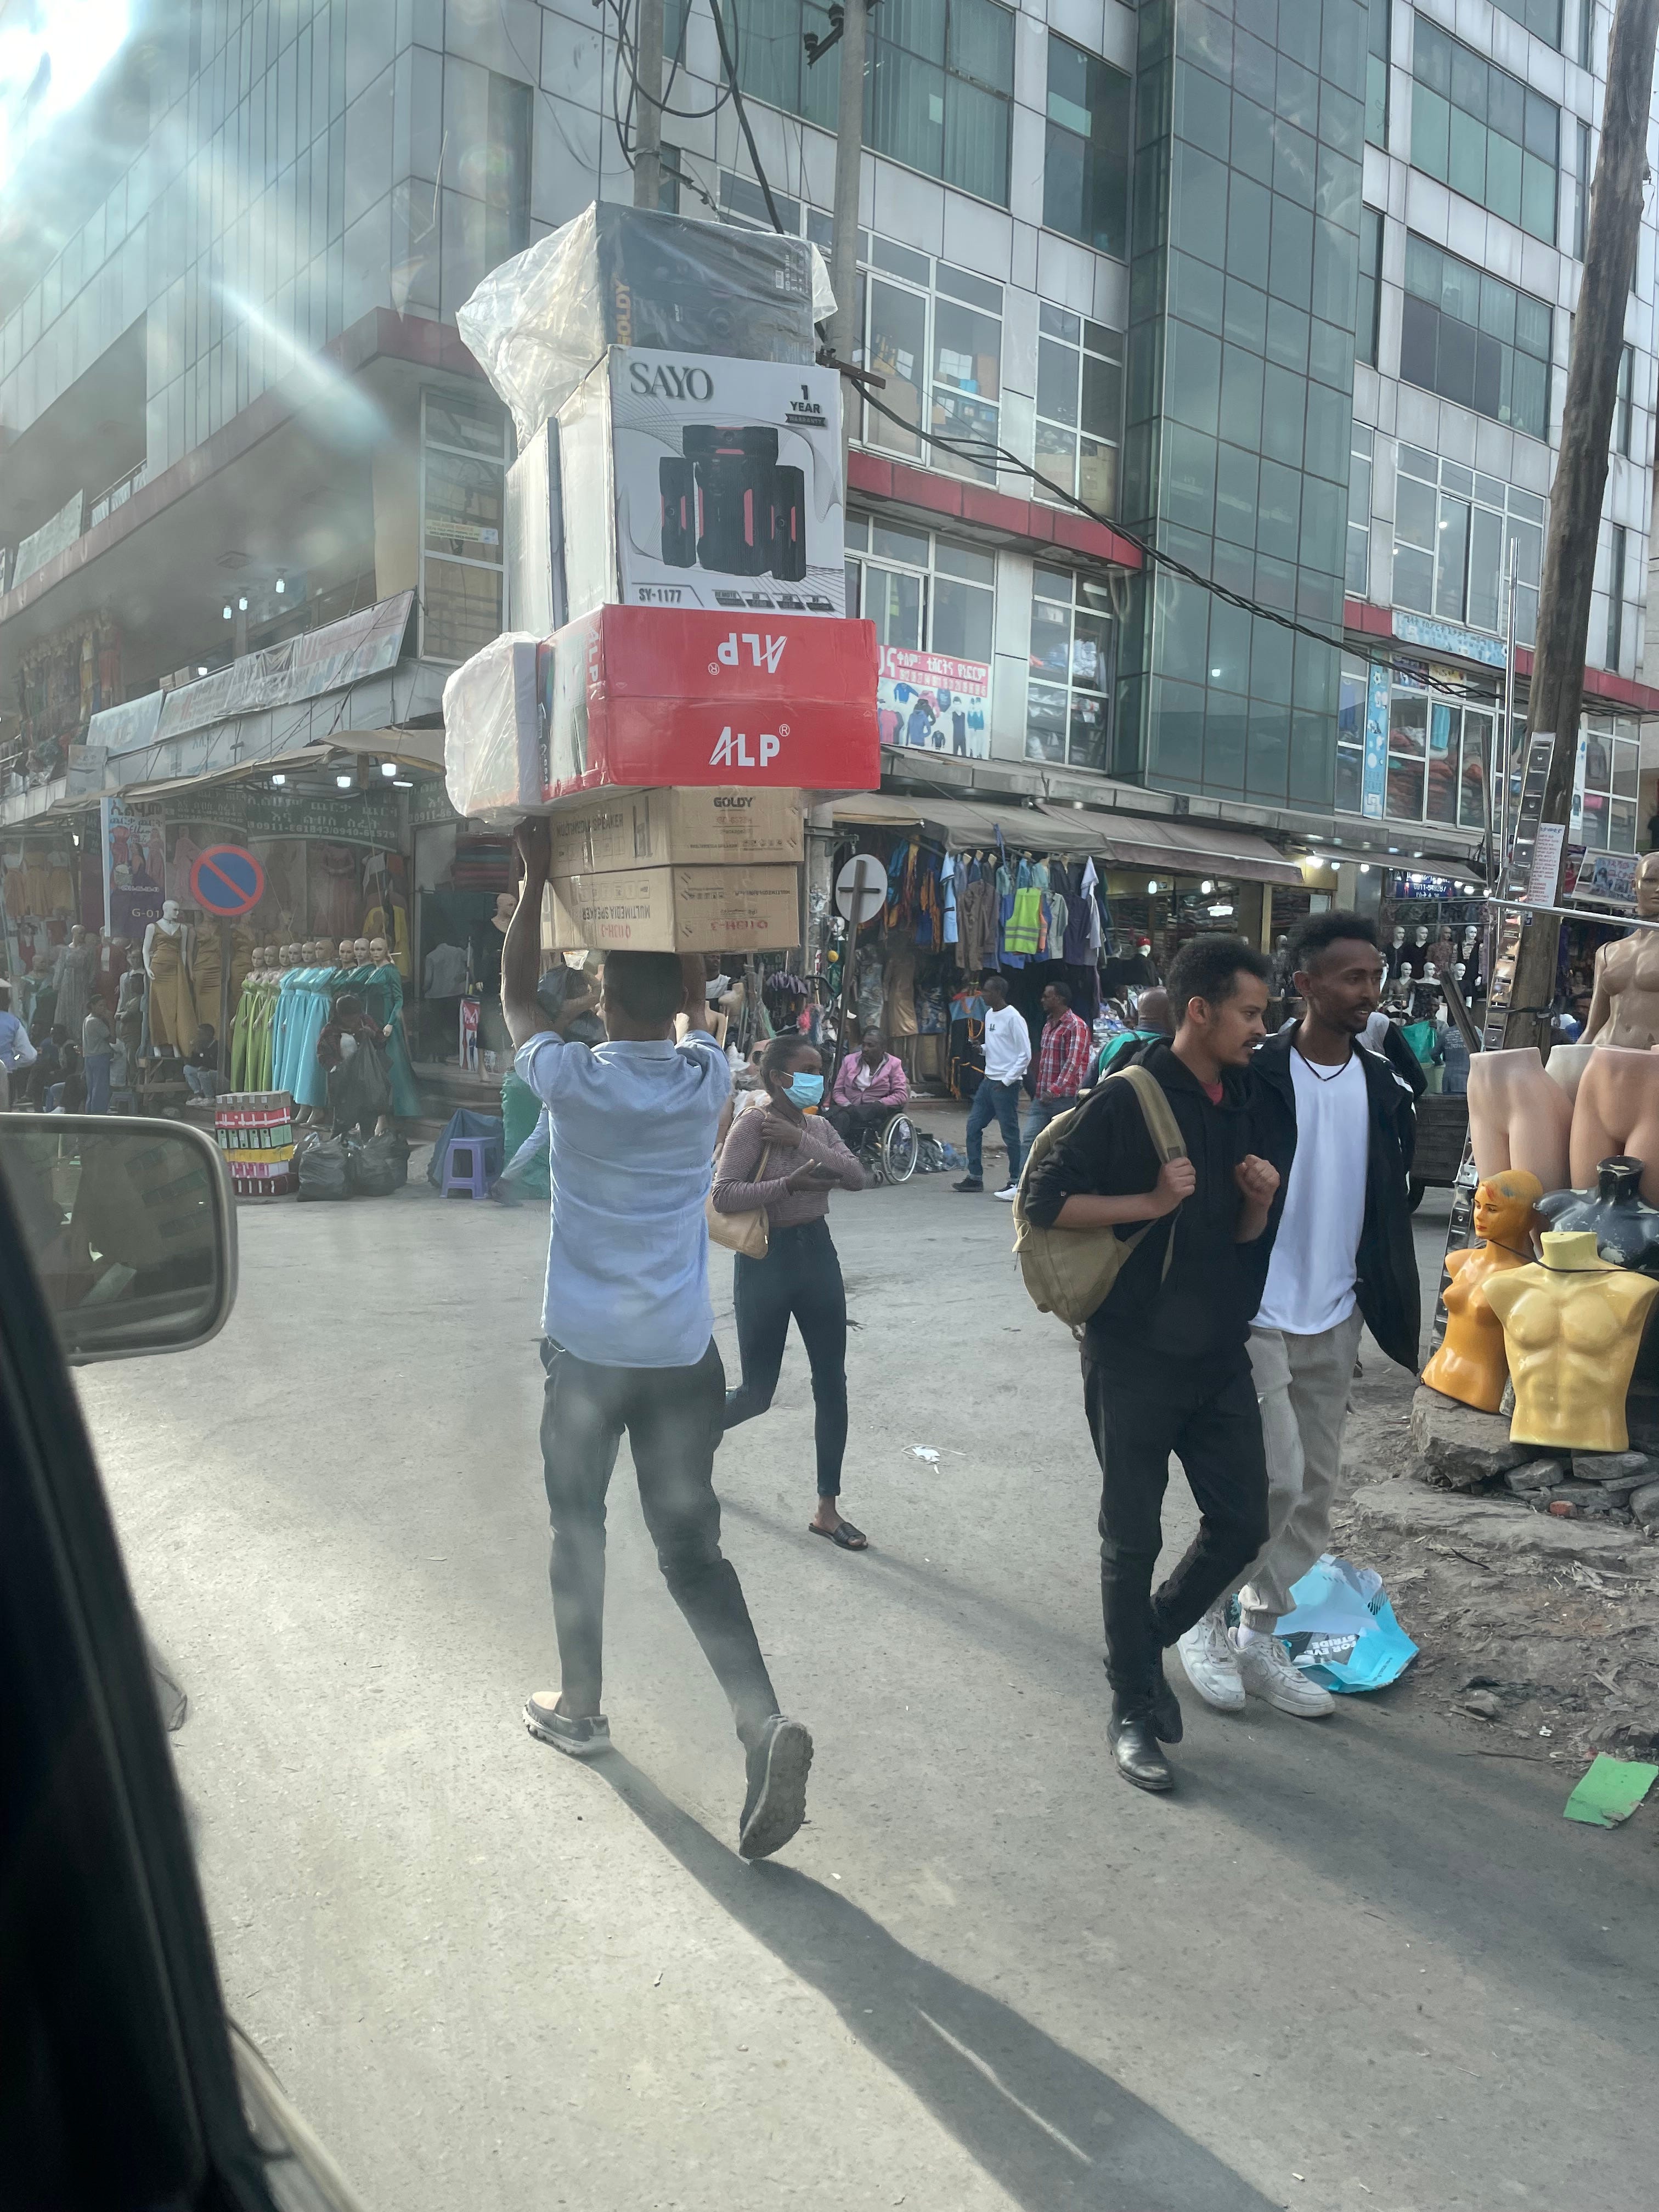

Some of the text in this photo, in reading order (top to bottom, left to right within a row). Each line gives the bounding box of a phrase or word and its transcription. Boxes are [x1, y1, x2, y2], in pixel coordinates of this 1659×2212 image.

[630, 362, 713, 401] SAYO
[801, 385, 809, 400] 1
[790, 401, 821, 414] YEAR
[639, 588, 681, 603] SY-1177
[585, 627, 600, 682] ALP
[714, 797, 753, 808] GOLDY
[582, 905, 651, 921] MULTIMEDIA SPEAKER
[1311, 1635, 1356, 1649] STRIDE
